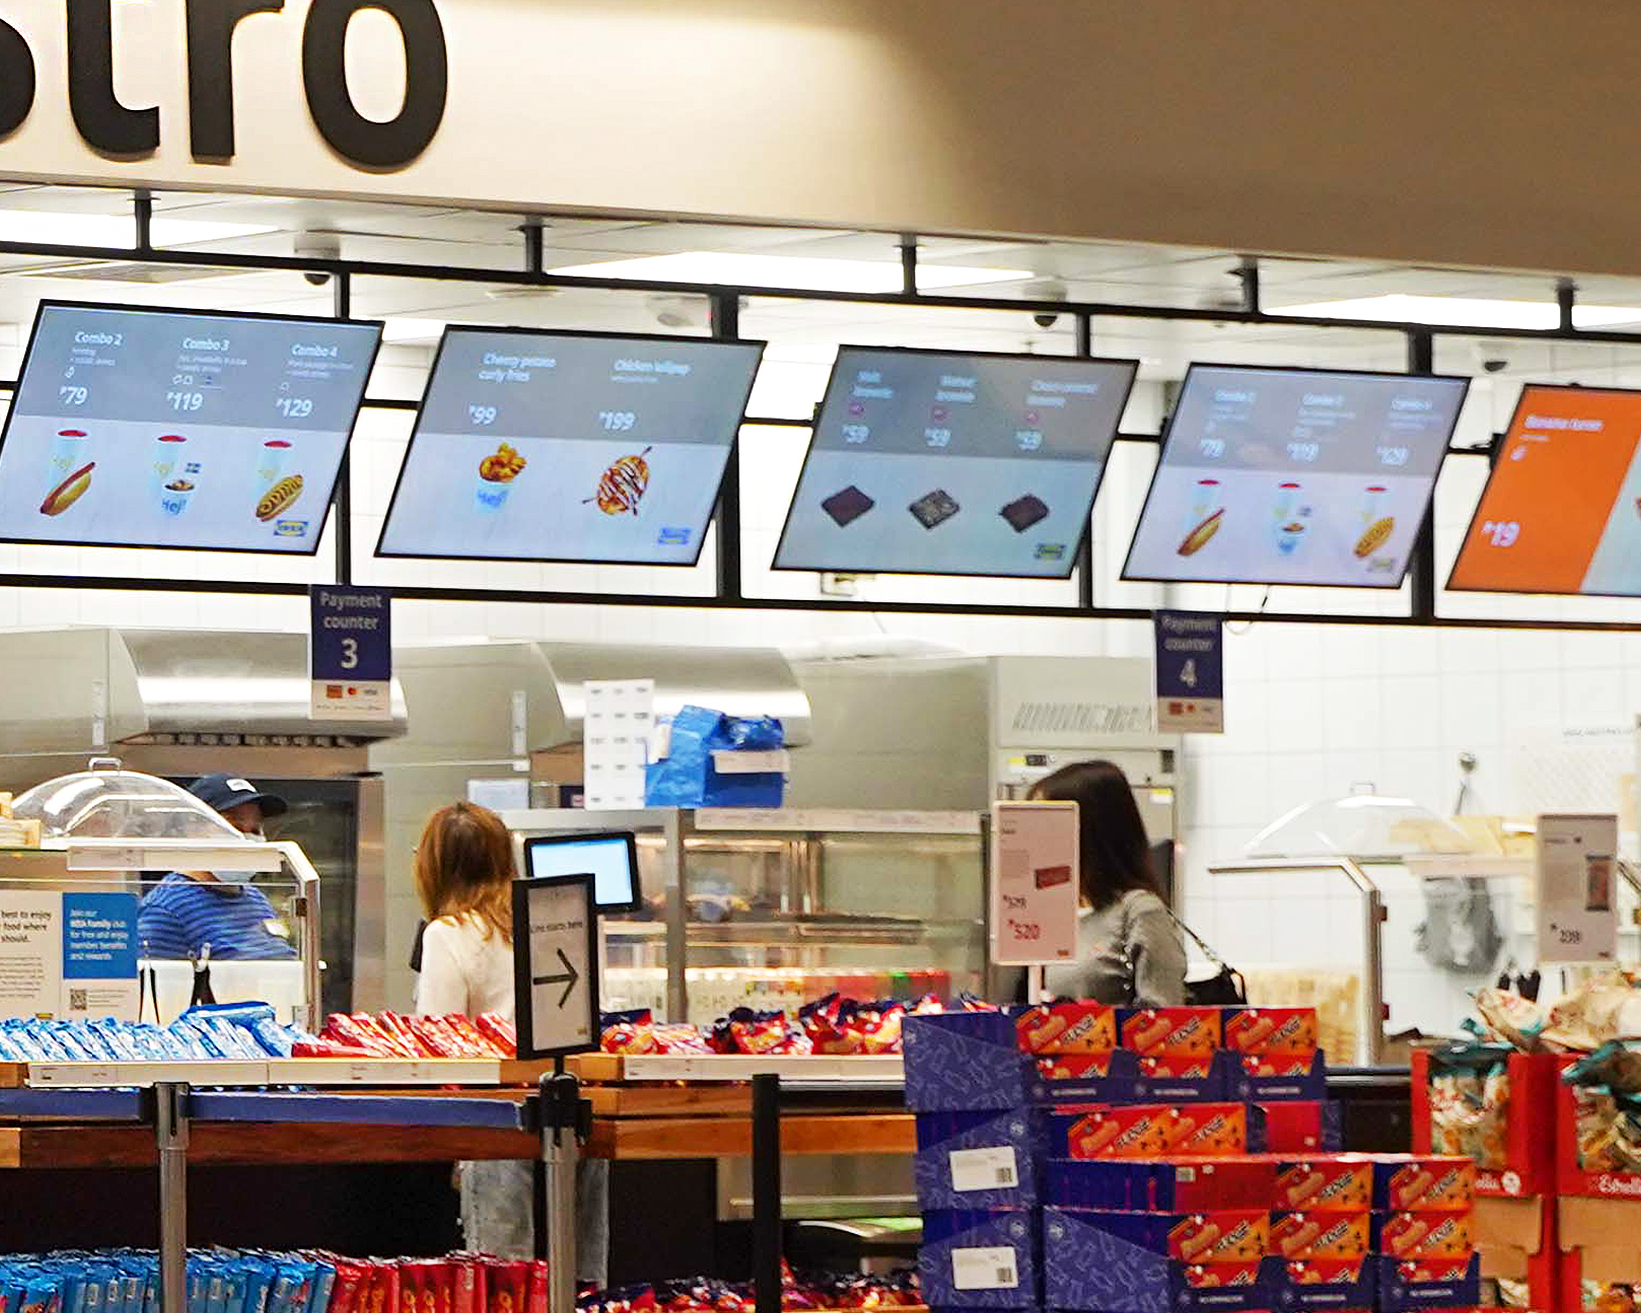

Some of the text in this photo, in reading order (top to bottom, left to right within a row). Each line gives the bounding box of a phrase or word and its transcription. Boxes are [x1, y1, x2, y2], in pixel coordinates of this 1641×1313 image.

[320, 591, 382, 611] Payment
[323, 616, 378, 630] counter
[340, 638, 358, 668] 3
[1180, 658, 1196, 688] 4
